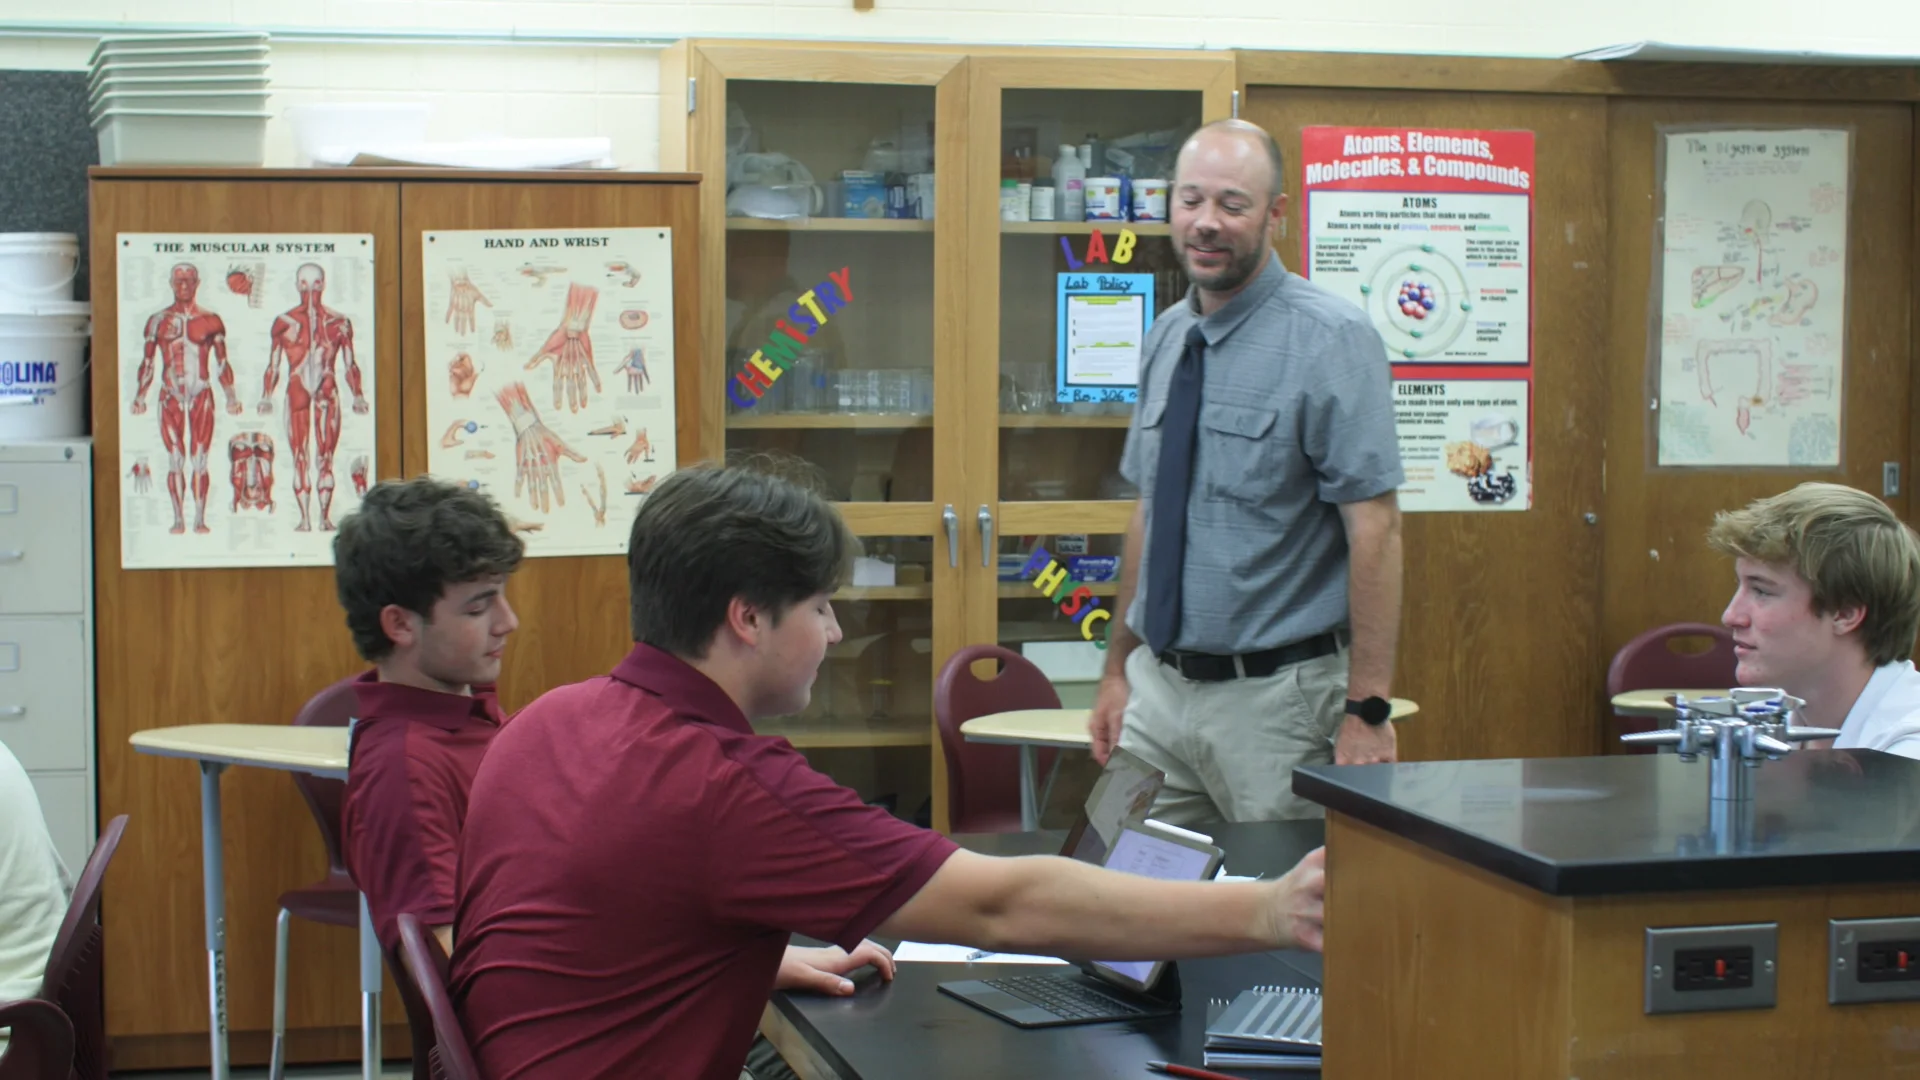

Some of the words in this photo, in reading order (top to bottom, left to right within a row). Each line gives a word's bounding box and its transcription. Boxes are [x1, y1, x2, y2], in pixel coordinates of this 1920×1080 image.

[1343, 134, 1405, 156] Atoms,
[1407, 131, 1494, 161] Elements,
[1306, 155, 1405, 185] Molecules,
[1407, 157, 1421, 176] &
[1423, 154, 1530, 190] Compounds
[1402, 197, 1437, 209] ATOMS
[1339, 210, 1361, 218] Atoms
[1375, 210, 1388, 219] tiny
[1390, 210, 1421, 219] particles
[1422, 211, 1436, 219] that
[1327, 222, 1349, 230] Atoms
[1363, 222, 1381, 230] made
[1383, 223, 1392, 231] up
[154, 242, 184, 253] THE
[190, 242, 270, 253] MUSCULAR
[276, 242, 336, 253] SYSTEM
[484, 238, 525, 249] HAND
[529, 238, 560, 248] AND
[564, 237, 610, 248] WRIST
[1060, 228, 1137, 270] LAB
[1065, 276, 1090, 290] Lab
[1096, 275, 1134, 294] Policy
[0, 361, 56, 386] OLINA
[1100, 388, 1125, 402] 306
[1398, 384, 1445, 395] ELEMENTS
